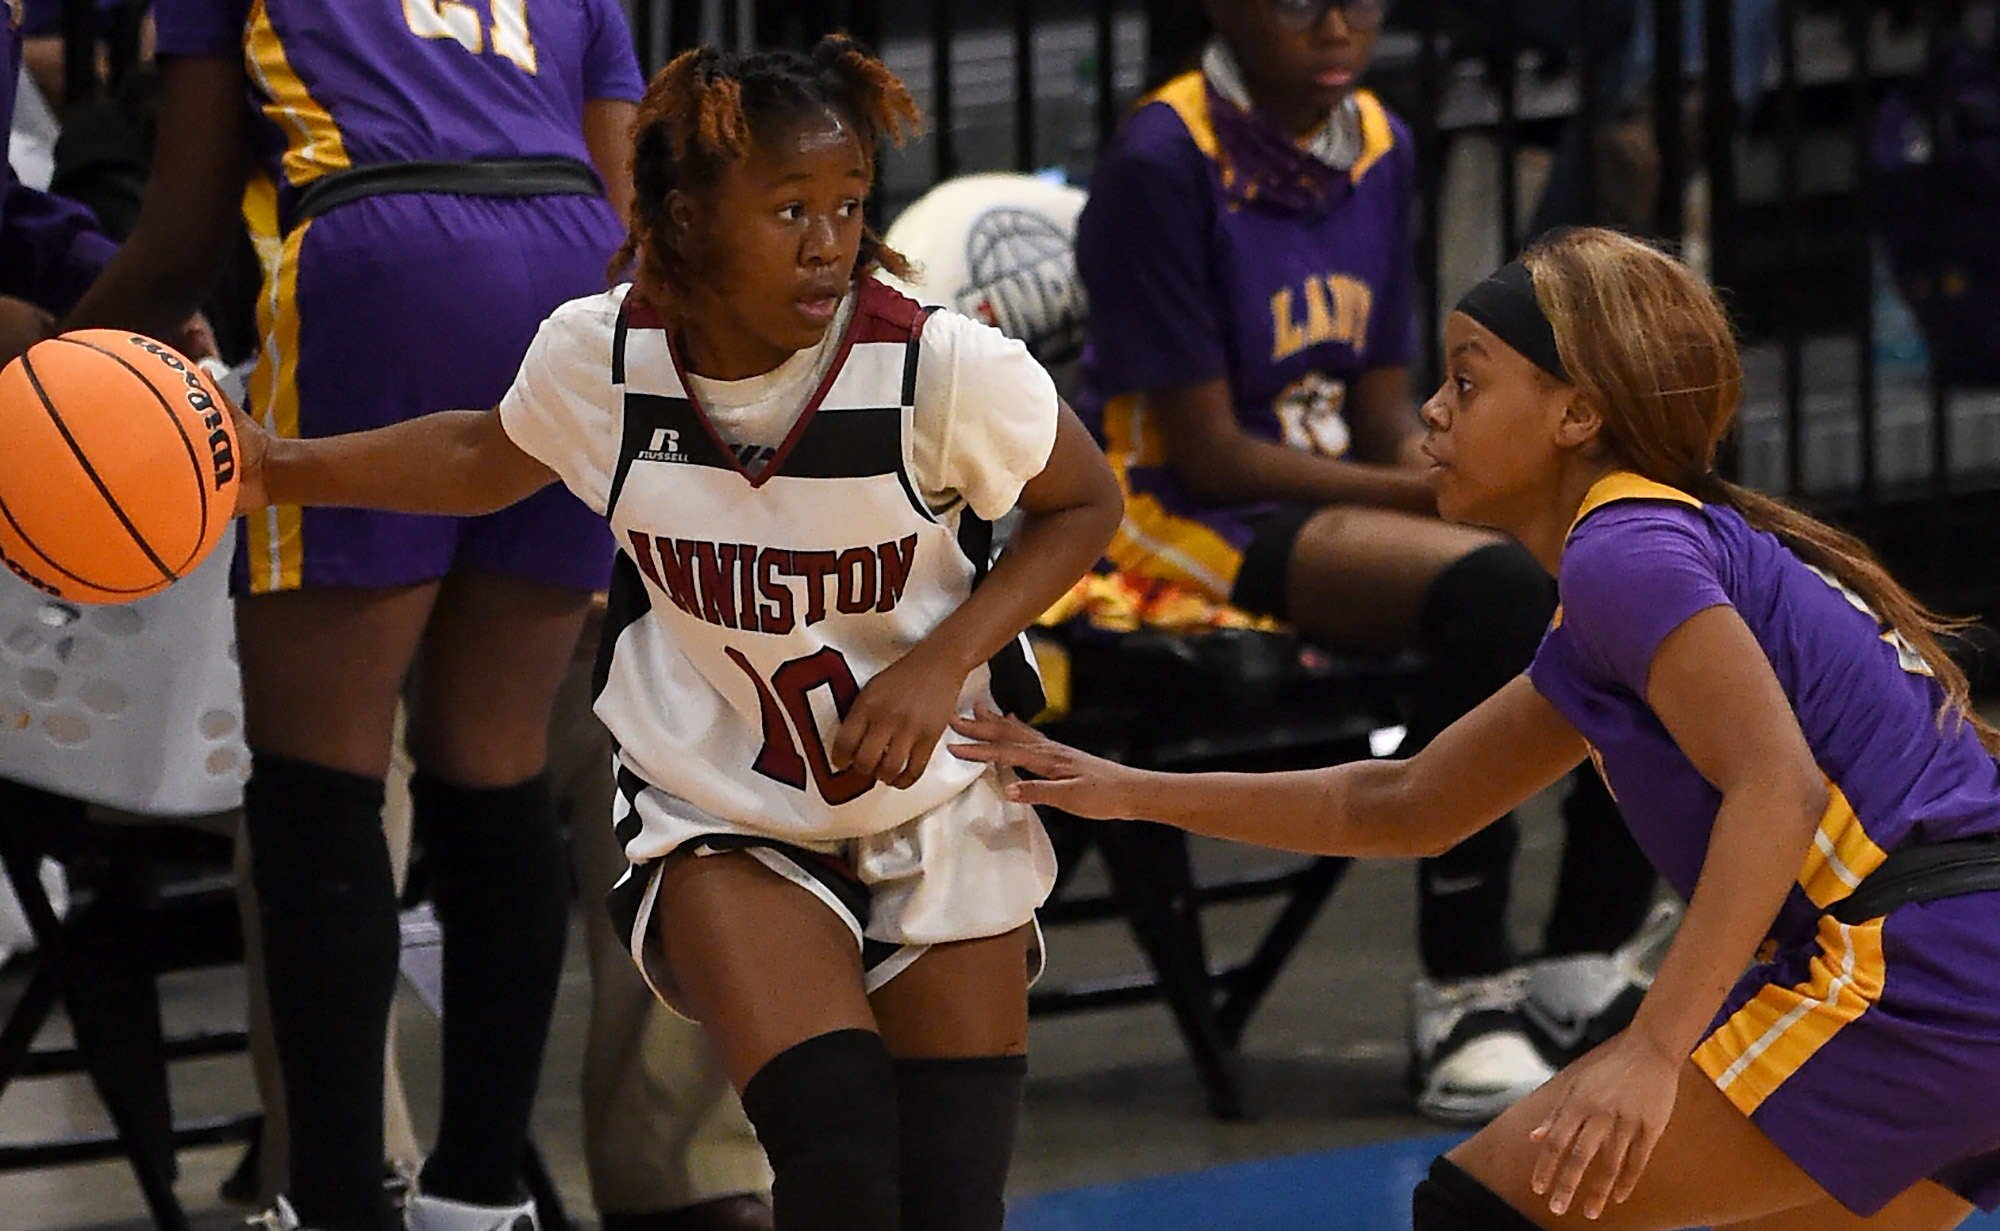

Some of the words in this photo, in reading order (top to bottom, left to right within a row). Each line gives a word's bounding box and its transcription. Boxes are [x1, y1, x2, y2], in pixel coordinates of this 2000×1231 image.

[129, 336, 235, 491] Wilson
[638, 450, 689, 462] RUSSELL
[724, 645, 878, 807] 10
